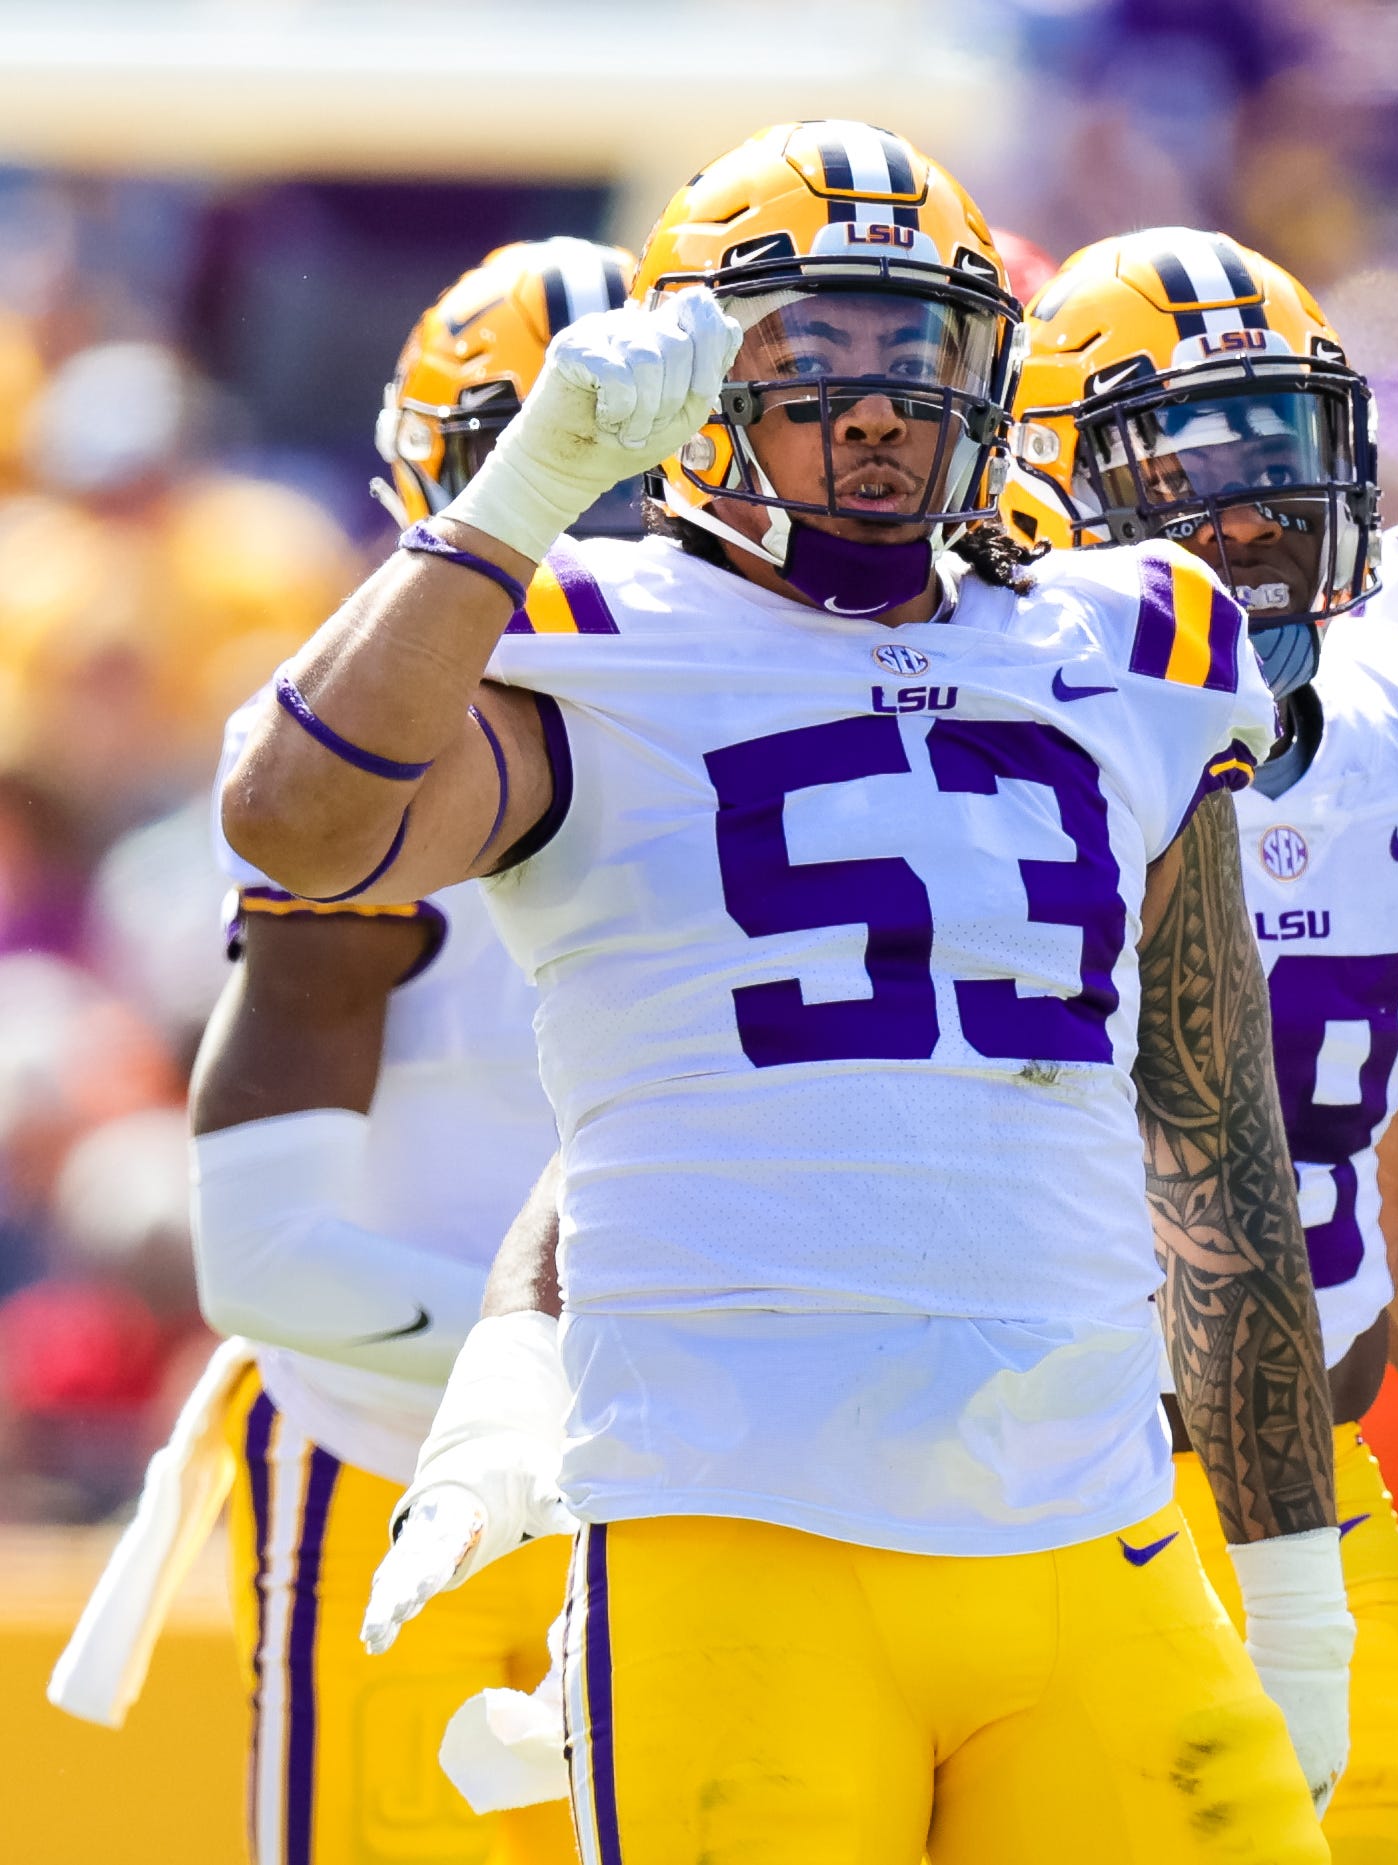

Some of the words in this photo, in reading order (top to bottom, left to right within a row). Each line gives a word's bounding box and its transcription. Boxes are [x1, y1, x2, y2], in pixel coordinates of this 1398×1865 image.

[847, 223, 914, 249] LSU
[1200, 331, 1266, 356] LSU
[877, 645, 928, 675] SEC
[871, 686, 958, 713] LSU
[1263, 828, 1306, 878] SEC
[703, 715, 1126, 1067] 53
[1255, 910, 1330, 941] LSU
